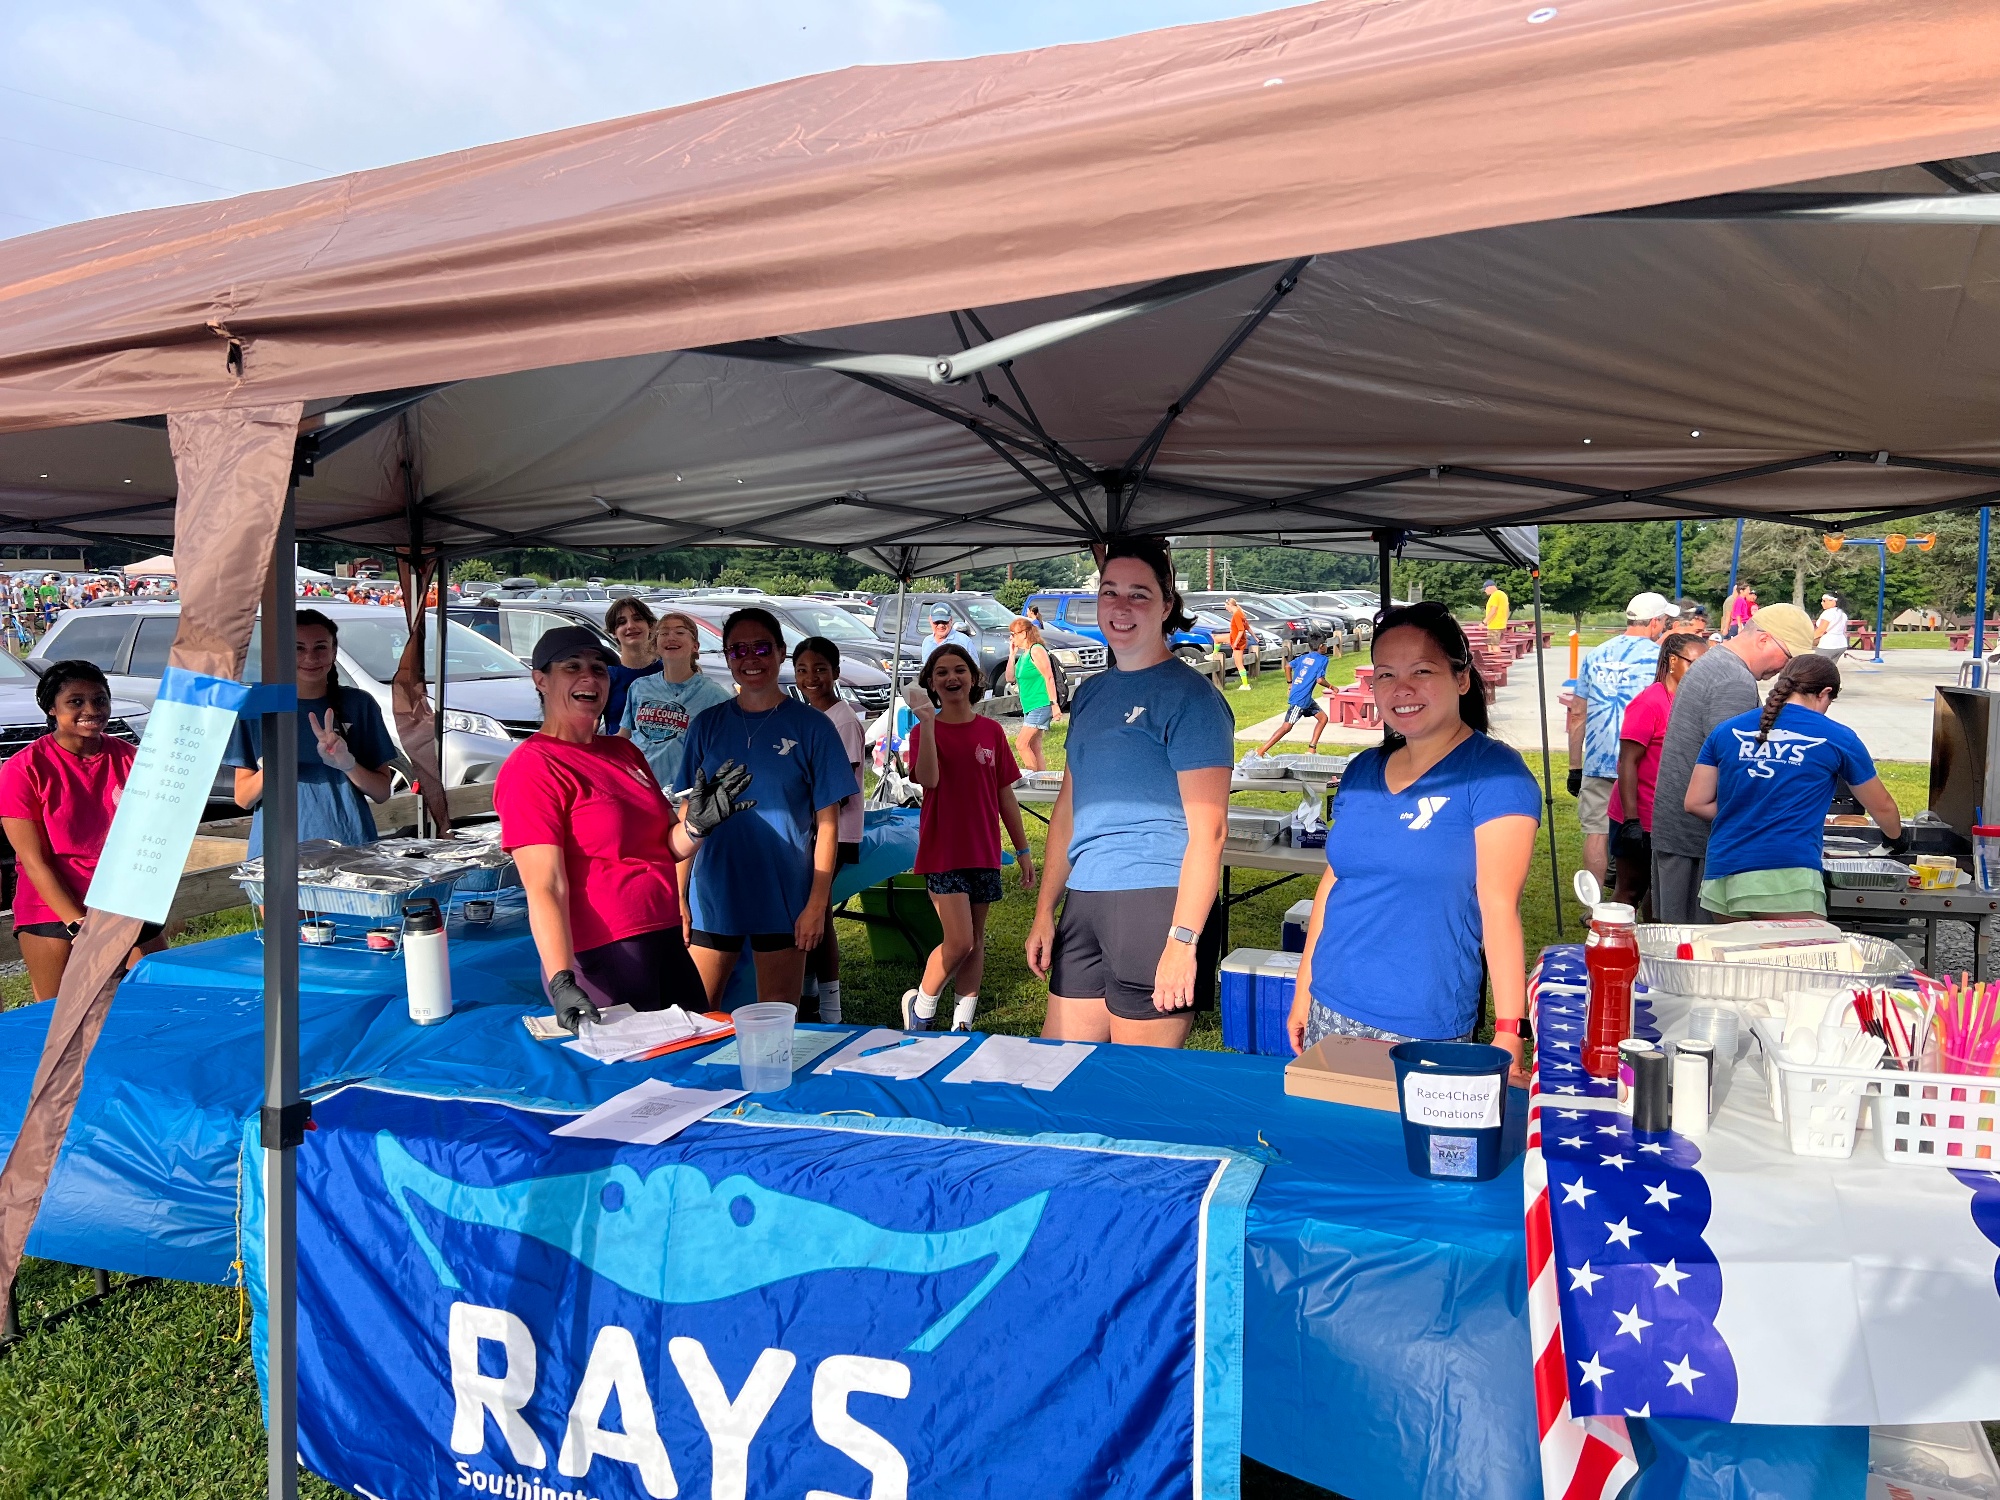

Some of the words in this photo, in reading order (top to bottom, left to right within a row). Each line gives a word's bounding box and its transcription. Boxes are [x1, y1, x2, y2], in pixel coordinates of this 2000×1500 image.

[1596, 671, 1630, 684] RAYS
[656, 709, 688, 723] COURSE
[179, 724, 206, 737] $4.00
[173, 737, 200, 749] $5.00
[170, 751, 197, 763] $5.00
[1739, 741, 1806, 763] RAYS
[164, 764, 190, 776] $6.00
[160, 778, 186, 790] $3.00
[154, 792, 181, 804] $4.00
[141, 834, 167, 846] $4.00
[136, 848, 162, 860] $5.00
[132, 862, 158, 874] $1.00
[1417, 1087, 1490, 1102] Race4Chase
[1423, 1106, 1484, 1119] Donations
[1438, 1150, 1466, 1160] RAYS
[449, 1301, 911, 1500] RAYS
[455, 1461, 600, 1500] Southin
